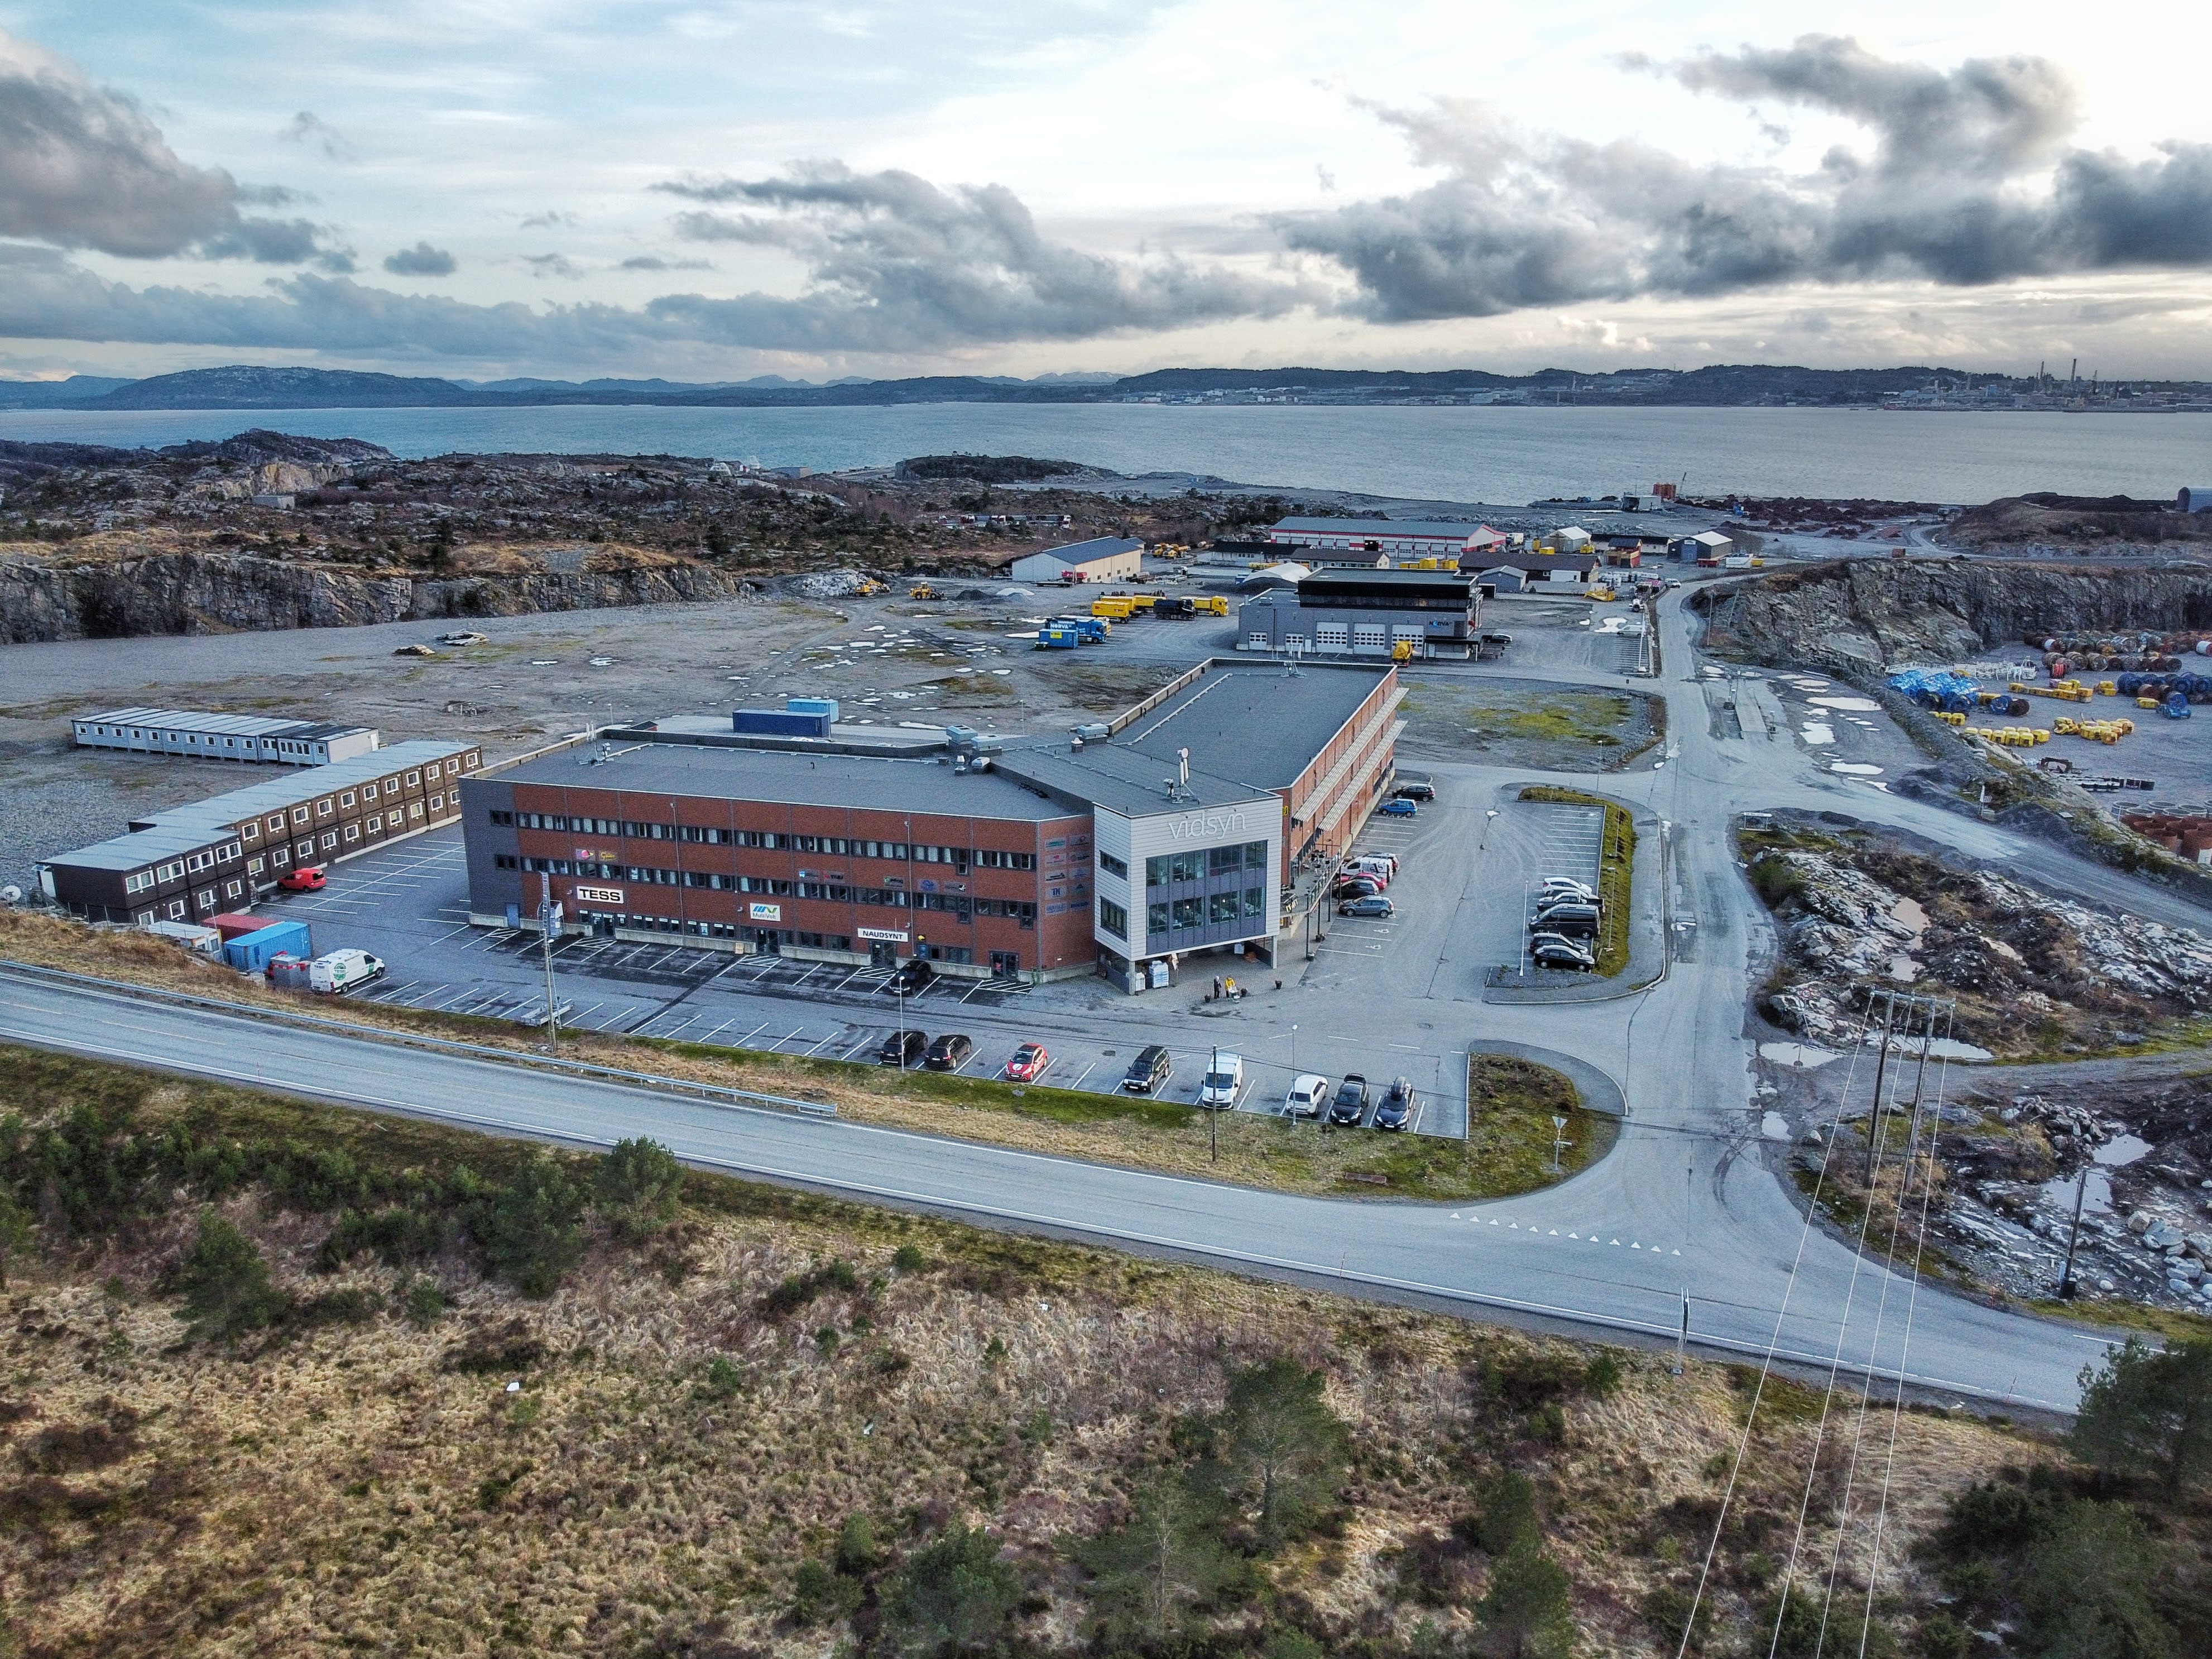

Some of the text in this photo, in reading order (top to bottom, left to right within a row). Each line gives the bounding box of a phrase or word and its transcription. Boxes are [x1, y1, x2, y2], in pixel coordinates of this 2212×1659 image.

[1168, 811, 1246, 840] vidsyn
[579, 889, 621, 902] TESS
[863, 931, 903, 940] NAUDSYNT
